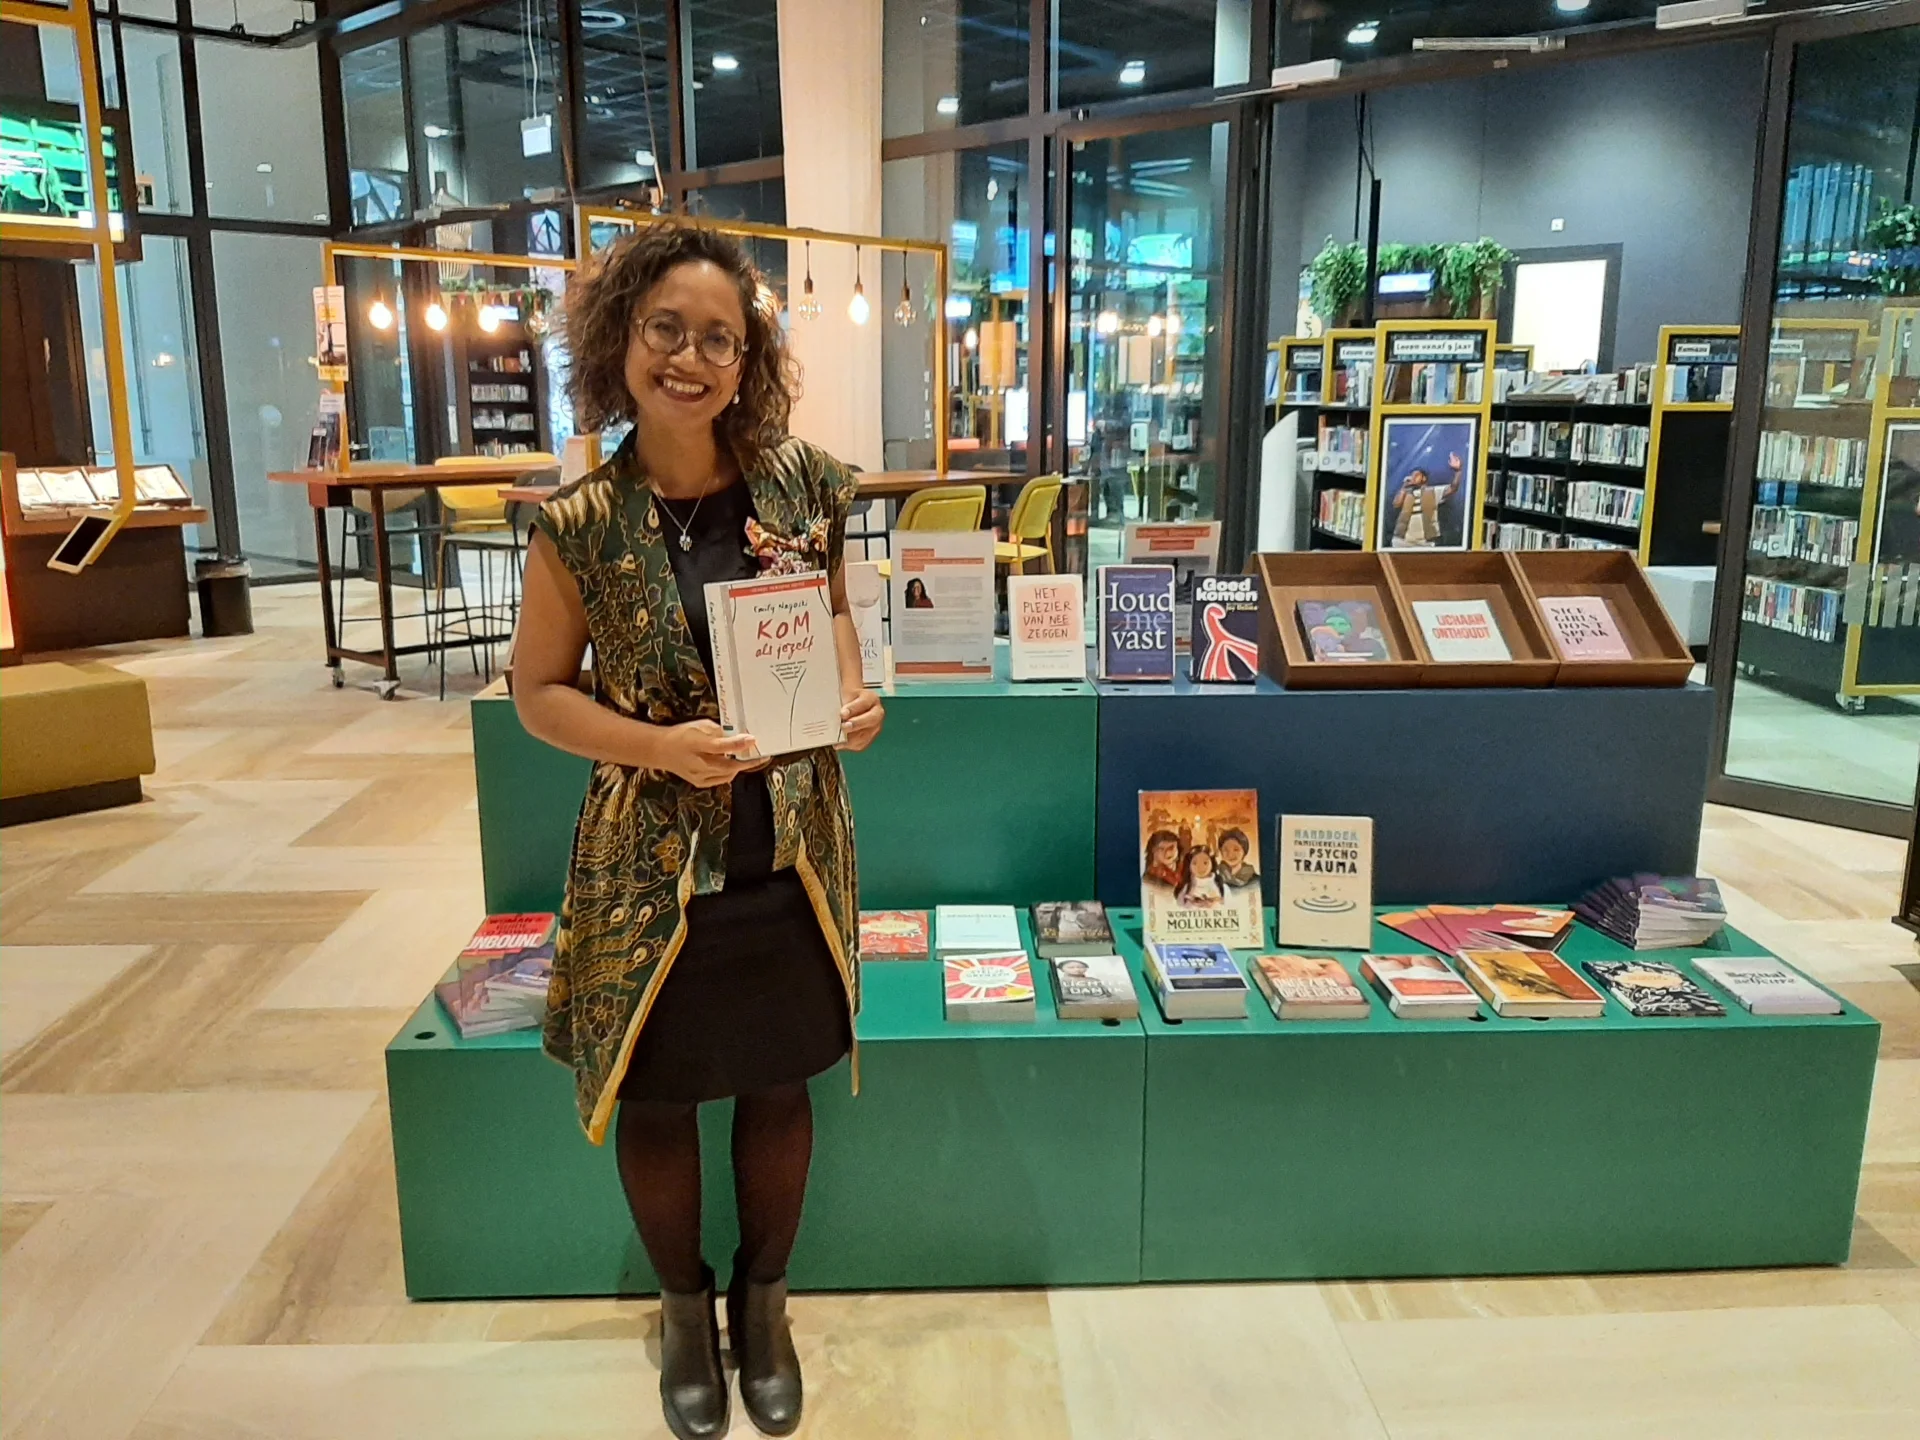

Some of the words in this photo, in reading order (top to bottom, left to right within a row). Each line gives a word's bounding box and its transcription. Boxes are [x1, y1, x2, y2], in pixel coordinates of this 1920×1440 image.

[1034, 587, 1058, 600] HET
[1097, 581, 1175, 613] Houd
[1195, 587, 1258, 602] komen
[753, 603, 775, 614] Emily
[1023, 600, 1072, 614] PLEZIER
[756, 610, 810, 640] KOM
[1022, 615, 1044, 626] VAN
[1049, 614, 1069, 626] NEE
[1124, 612, 1168, 631] me
[1027, 628, 1069, 640] ZEGGEN
[1111, 628, 1168, 651] vast
[1431, 626, 1491, 640] ONTHOUDT
[755, 642, 773, 658] als
[776, 635, 814, 660] jezelf
[1294, 829, 1359, 841] HANDBOEK
[1308, 847, 1359, 860] PSYCHO
[1293, 858, 1358, 874] TRAUMA
[1166, 910, 1208, 918] WORTELS
[1167, 917, 1240, 930] MOLUKKEN
